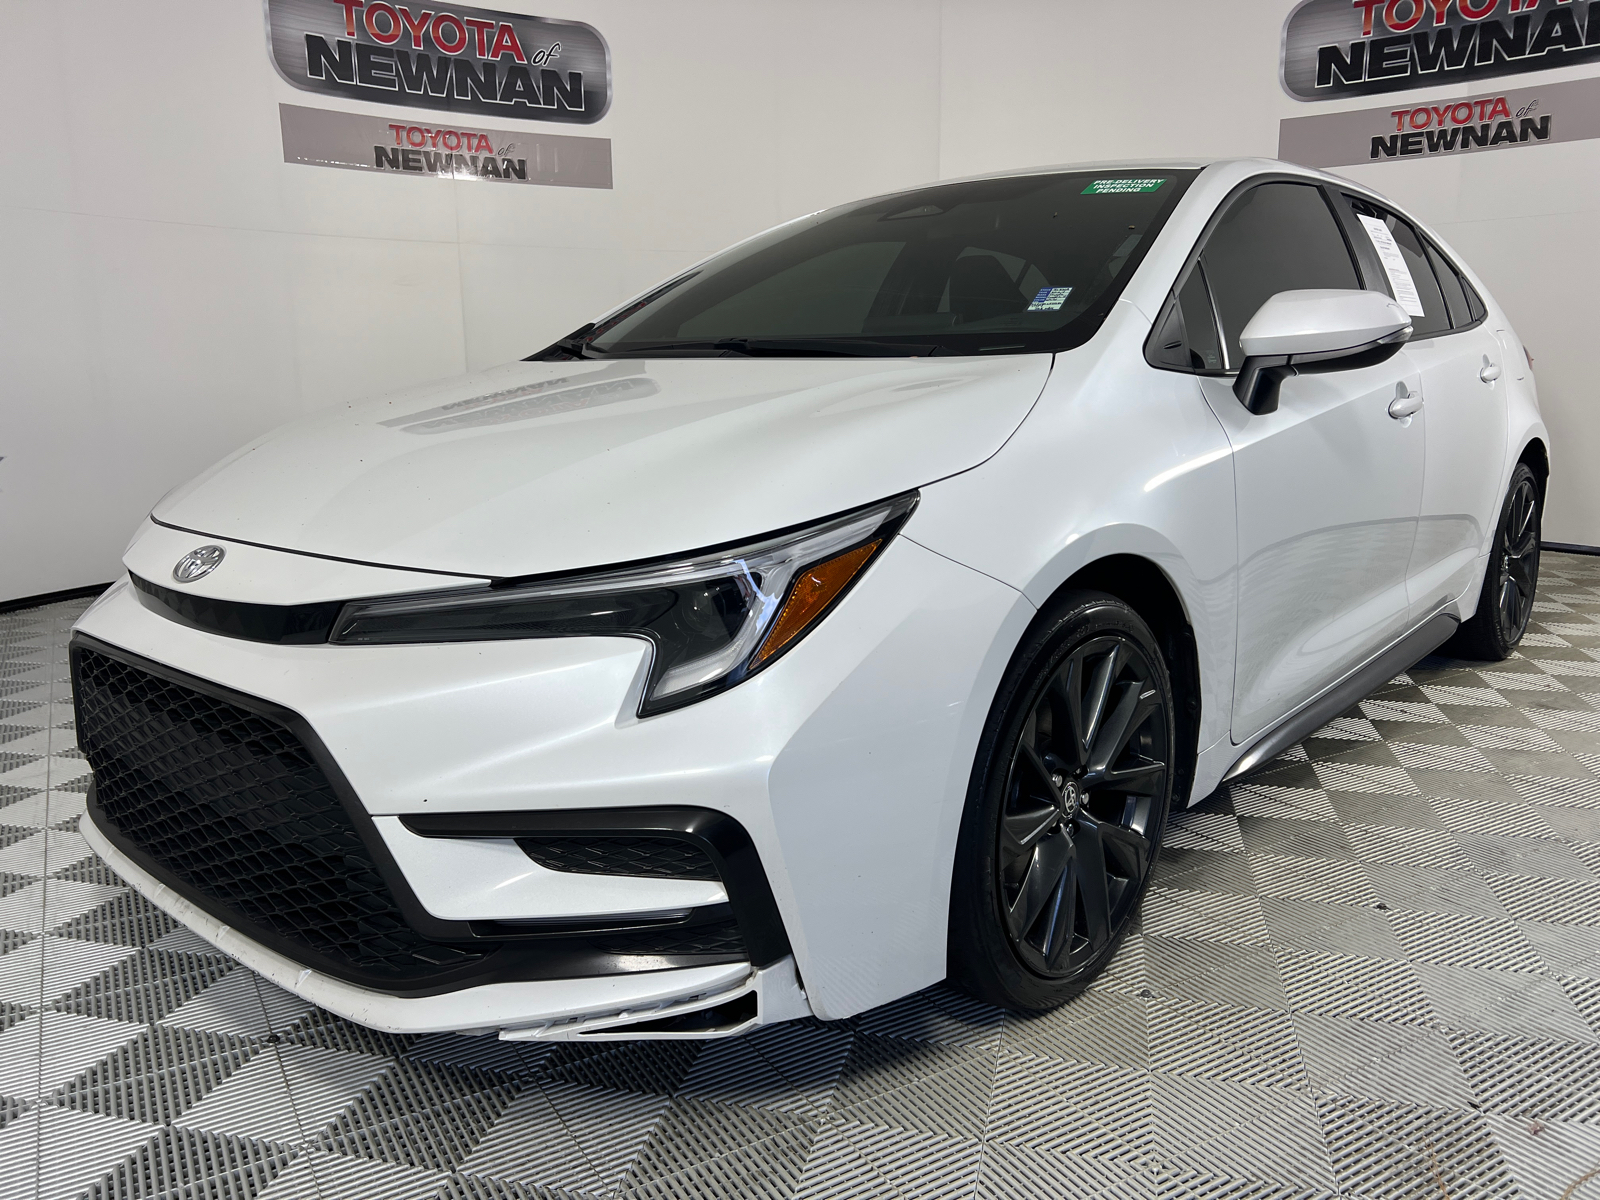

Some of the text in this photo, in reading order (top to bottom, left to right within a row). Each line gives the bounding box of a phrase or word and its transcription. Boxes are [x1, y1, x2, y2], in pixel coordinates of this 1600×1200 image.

[332, 0, 562, 66] TOYOTA of
[1353, 0, 1569, 37] TOYO
[1314, 1, 1600, 88] NEWNA
[304, 33, 586, 112] NEWNAN
[1391, 96, 1539, 132] TOYOTA of
[388, 123, 515, 157] TOYOTA of
[1370, 114, 1551, 160] NEWNAN
[373, 145, 529, 181] NEWNAN
